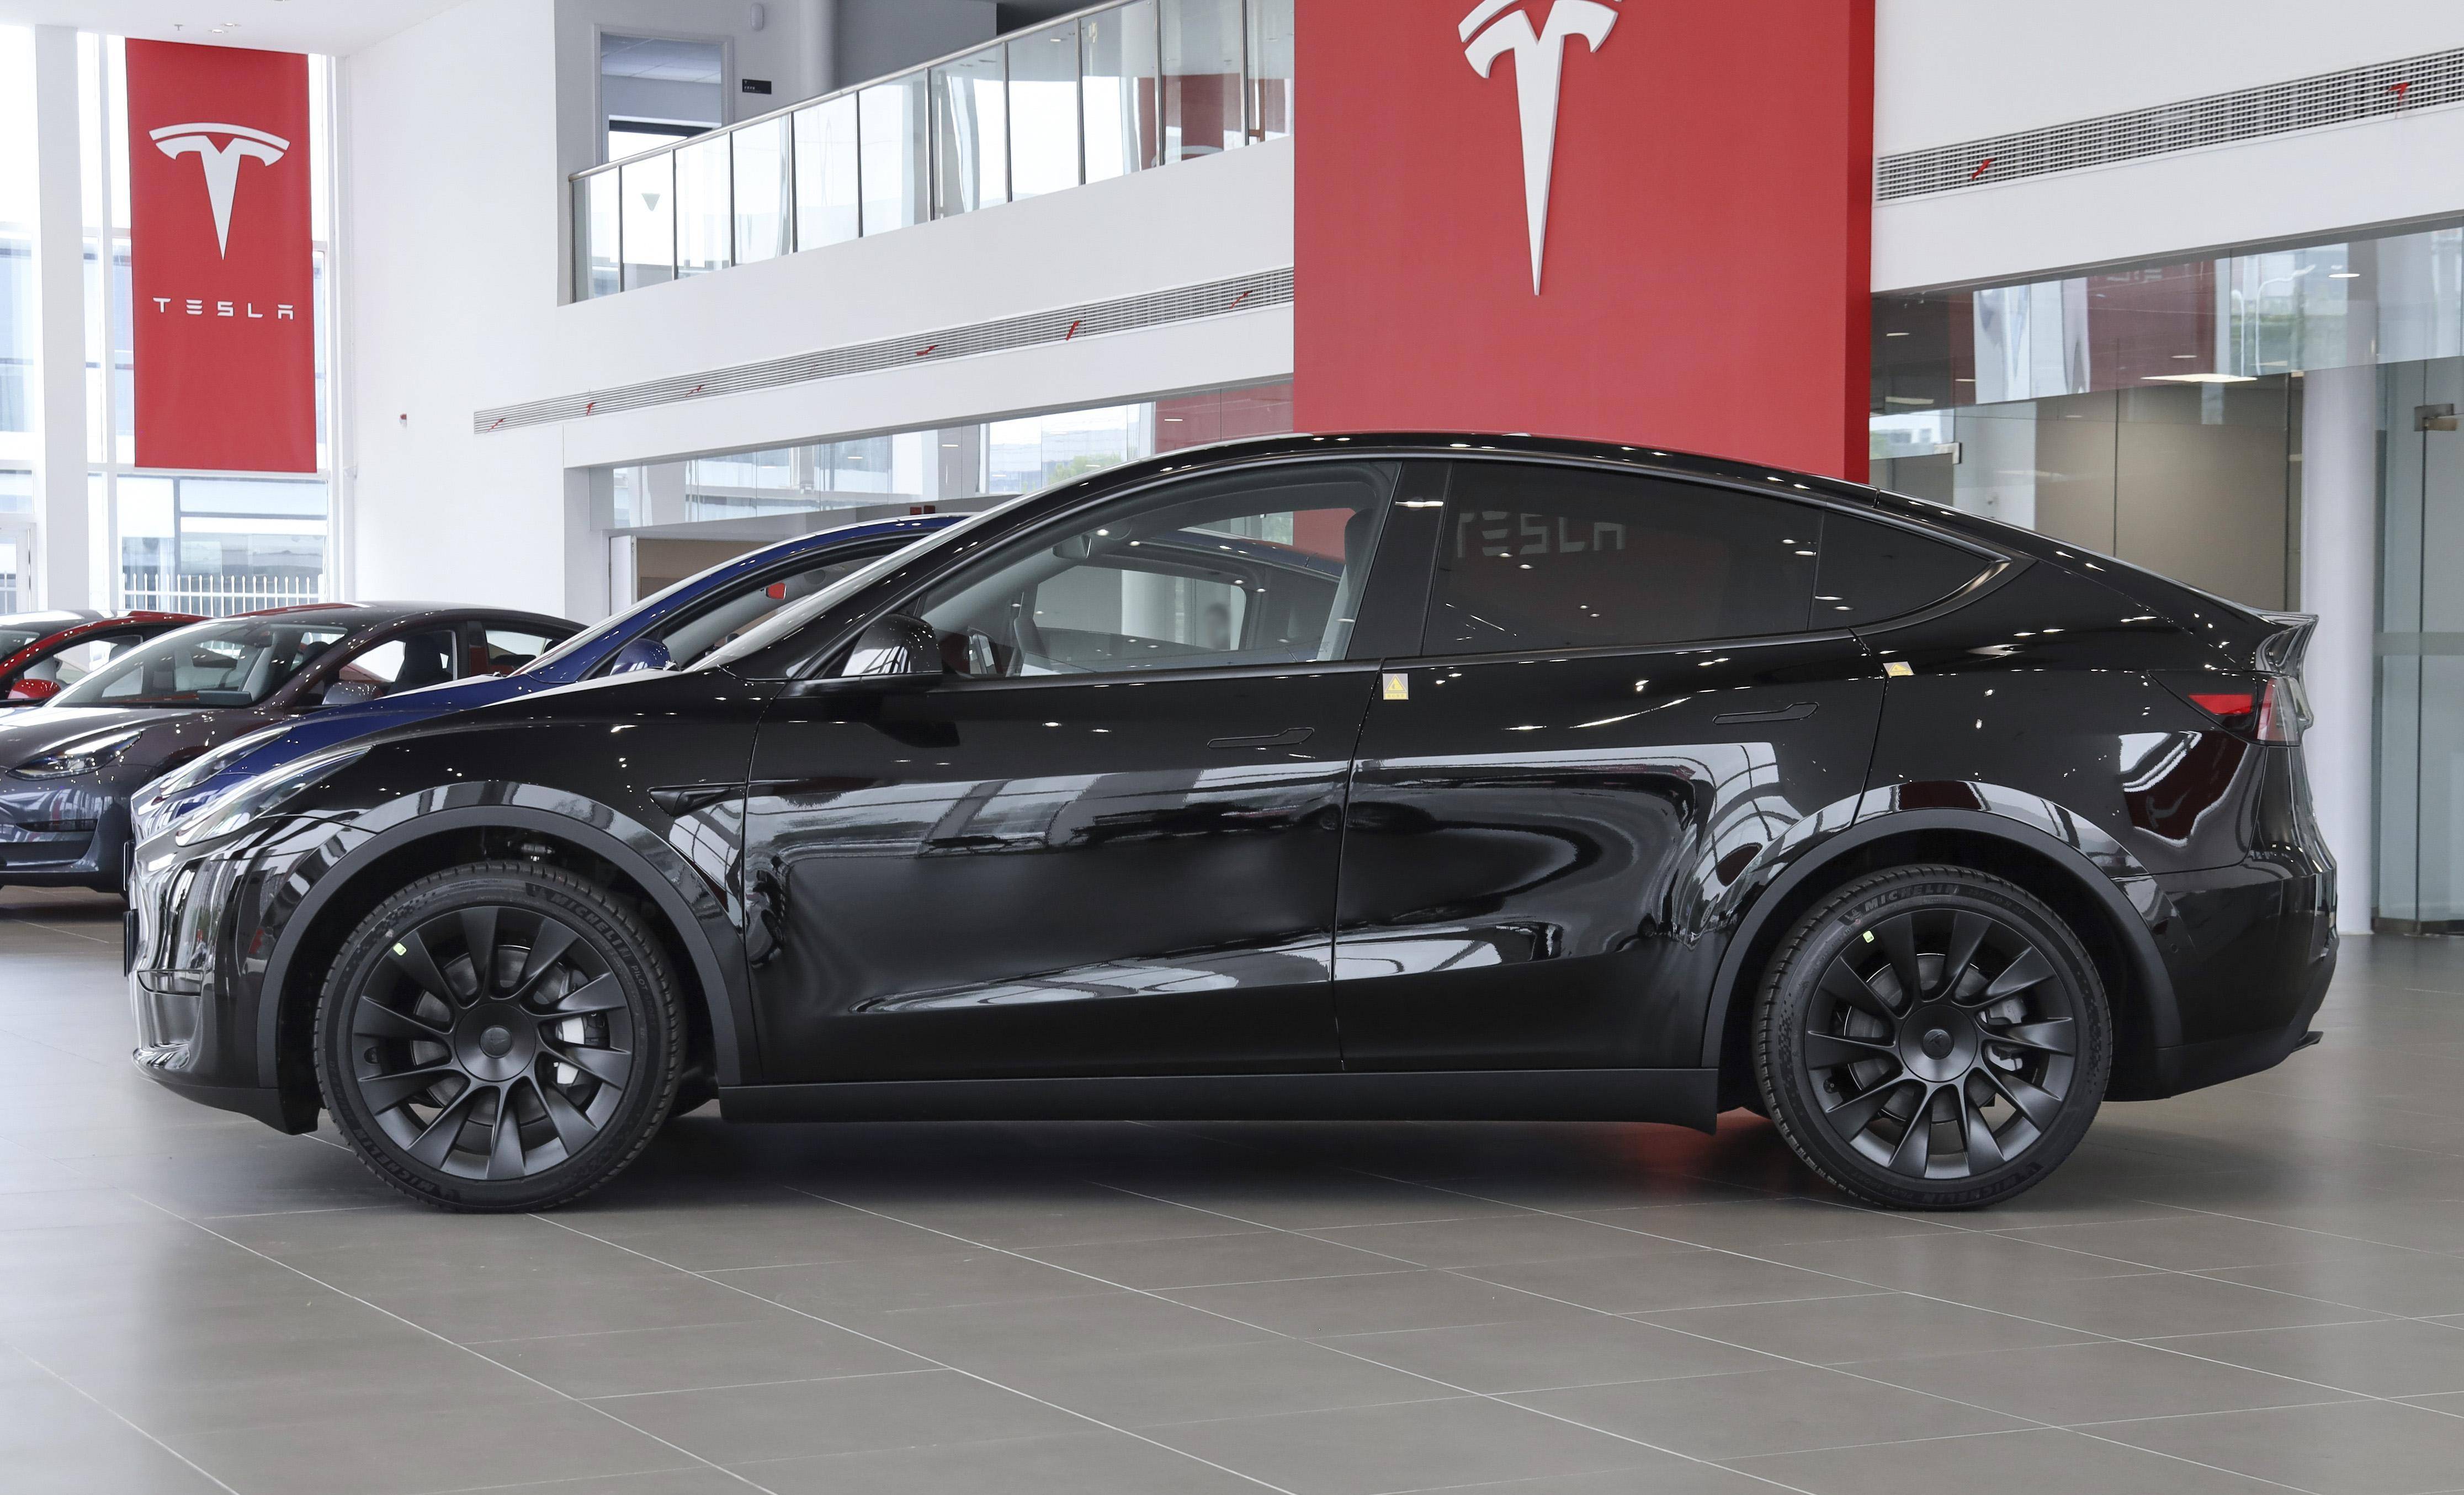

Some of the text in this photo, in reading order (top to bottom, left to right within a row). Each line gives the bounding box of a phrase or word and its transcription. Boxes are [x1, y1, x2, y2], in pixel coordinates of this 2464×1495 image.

[152, 297, 294, 320] TESLA
[1865, 884, 1959, 911] MICHELIN
[550, 893, 633, 958] MICHELIN
[630, 964, 649, 990] PILOT
